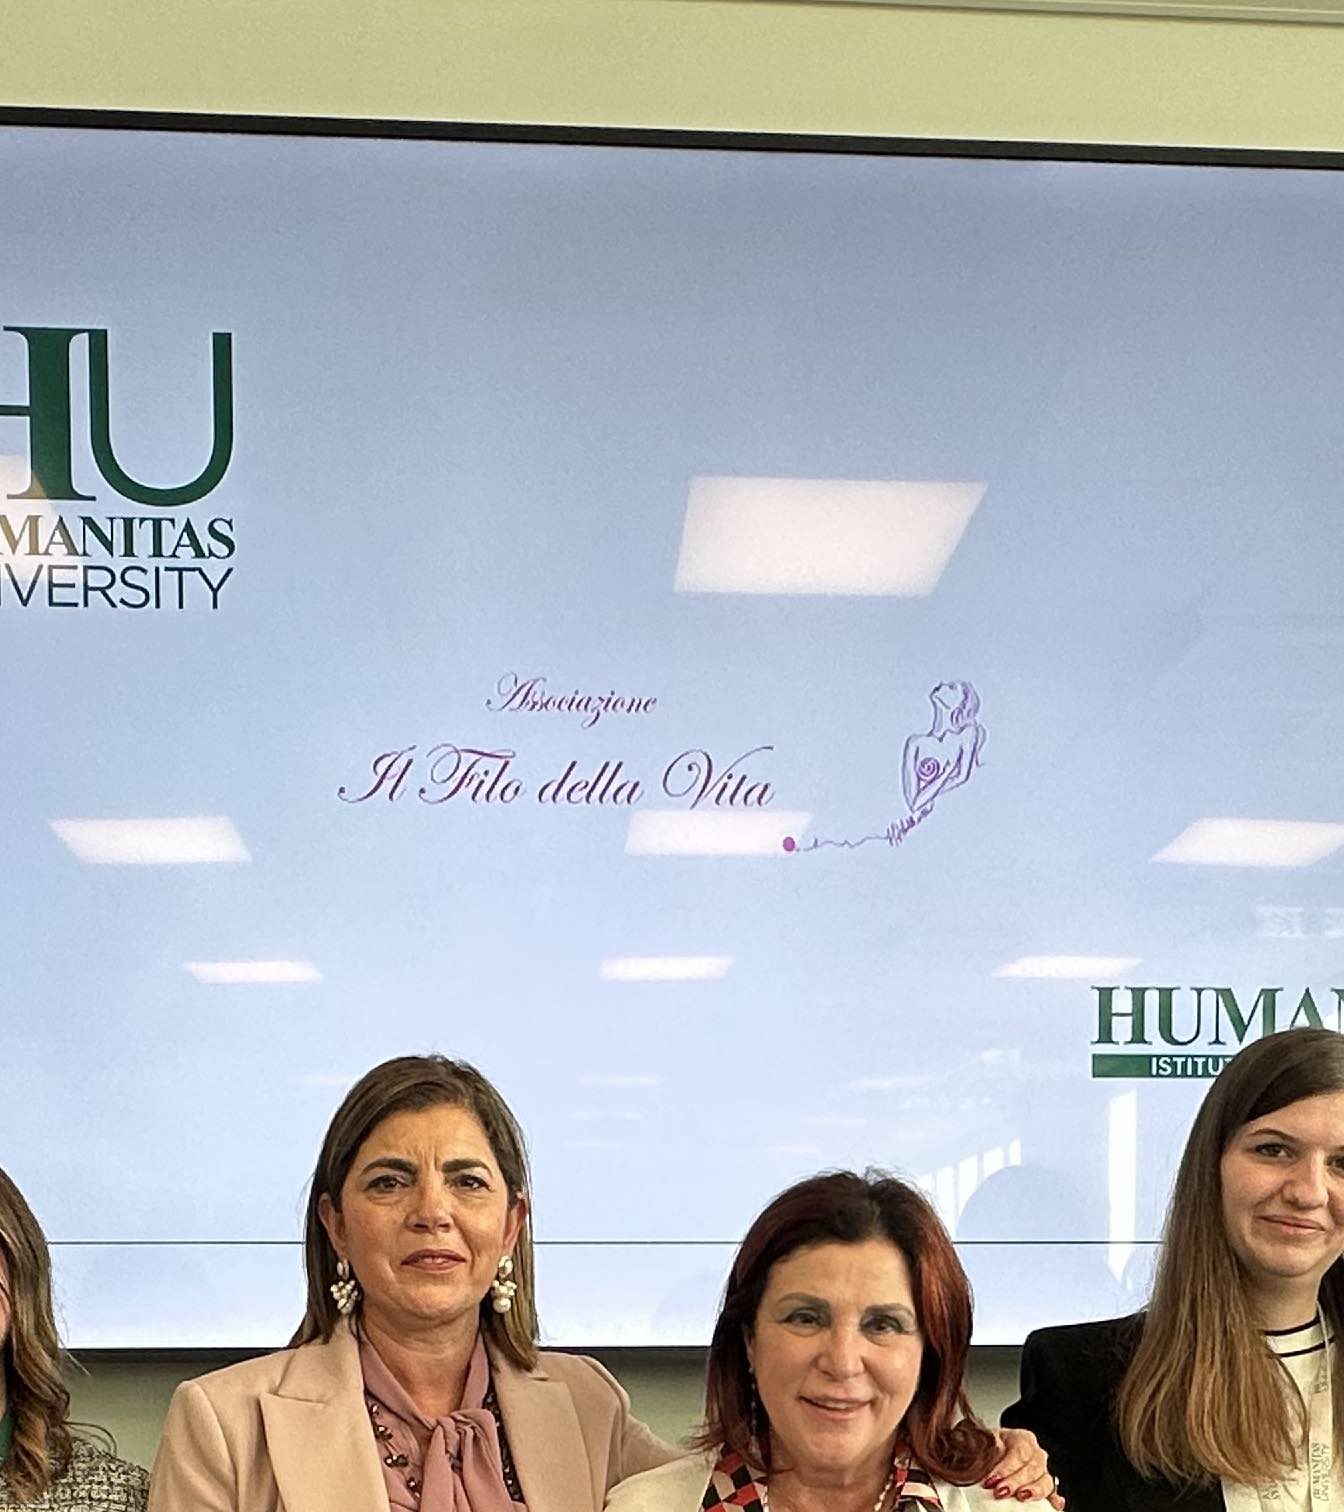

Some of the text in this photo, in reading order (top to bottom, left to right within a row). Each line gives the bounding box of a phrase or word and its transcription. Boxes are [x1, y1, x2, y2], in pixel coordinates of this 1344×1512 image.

[485, 671, 658, 728] Associazione
[338, 744, 774, 808] Il Filo della Vita
[1151, 1055, 1233, 1078] ISTITU
